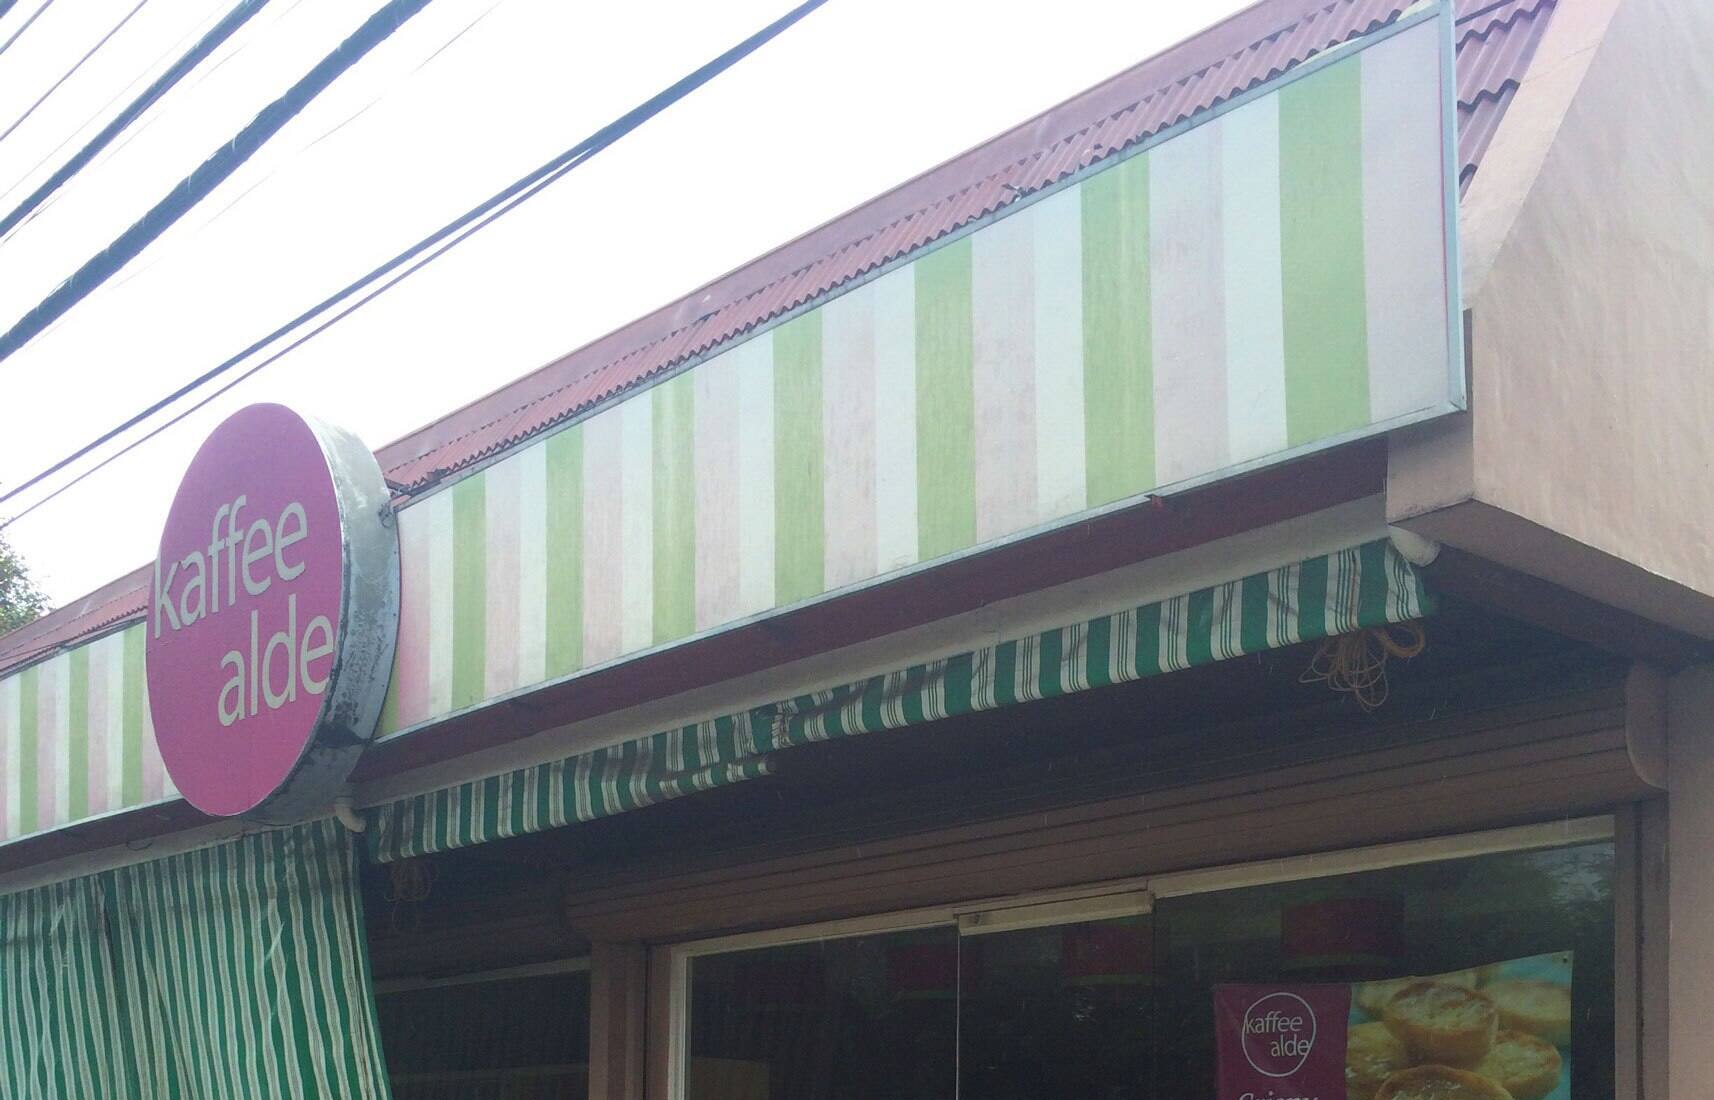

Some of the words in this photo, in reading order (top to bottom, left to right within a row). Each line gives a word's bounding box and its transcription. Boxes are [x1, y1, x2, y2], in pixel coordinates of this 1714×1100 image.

[155, 495, 308, 638] kaffee
[219, 594, 334, 727] alde
[1246, 1011, 1303, 1034] kaffee
[1271, 1034, 1311, 1057] alde
